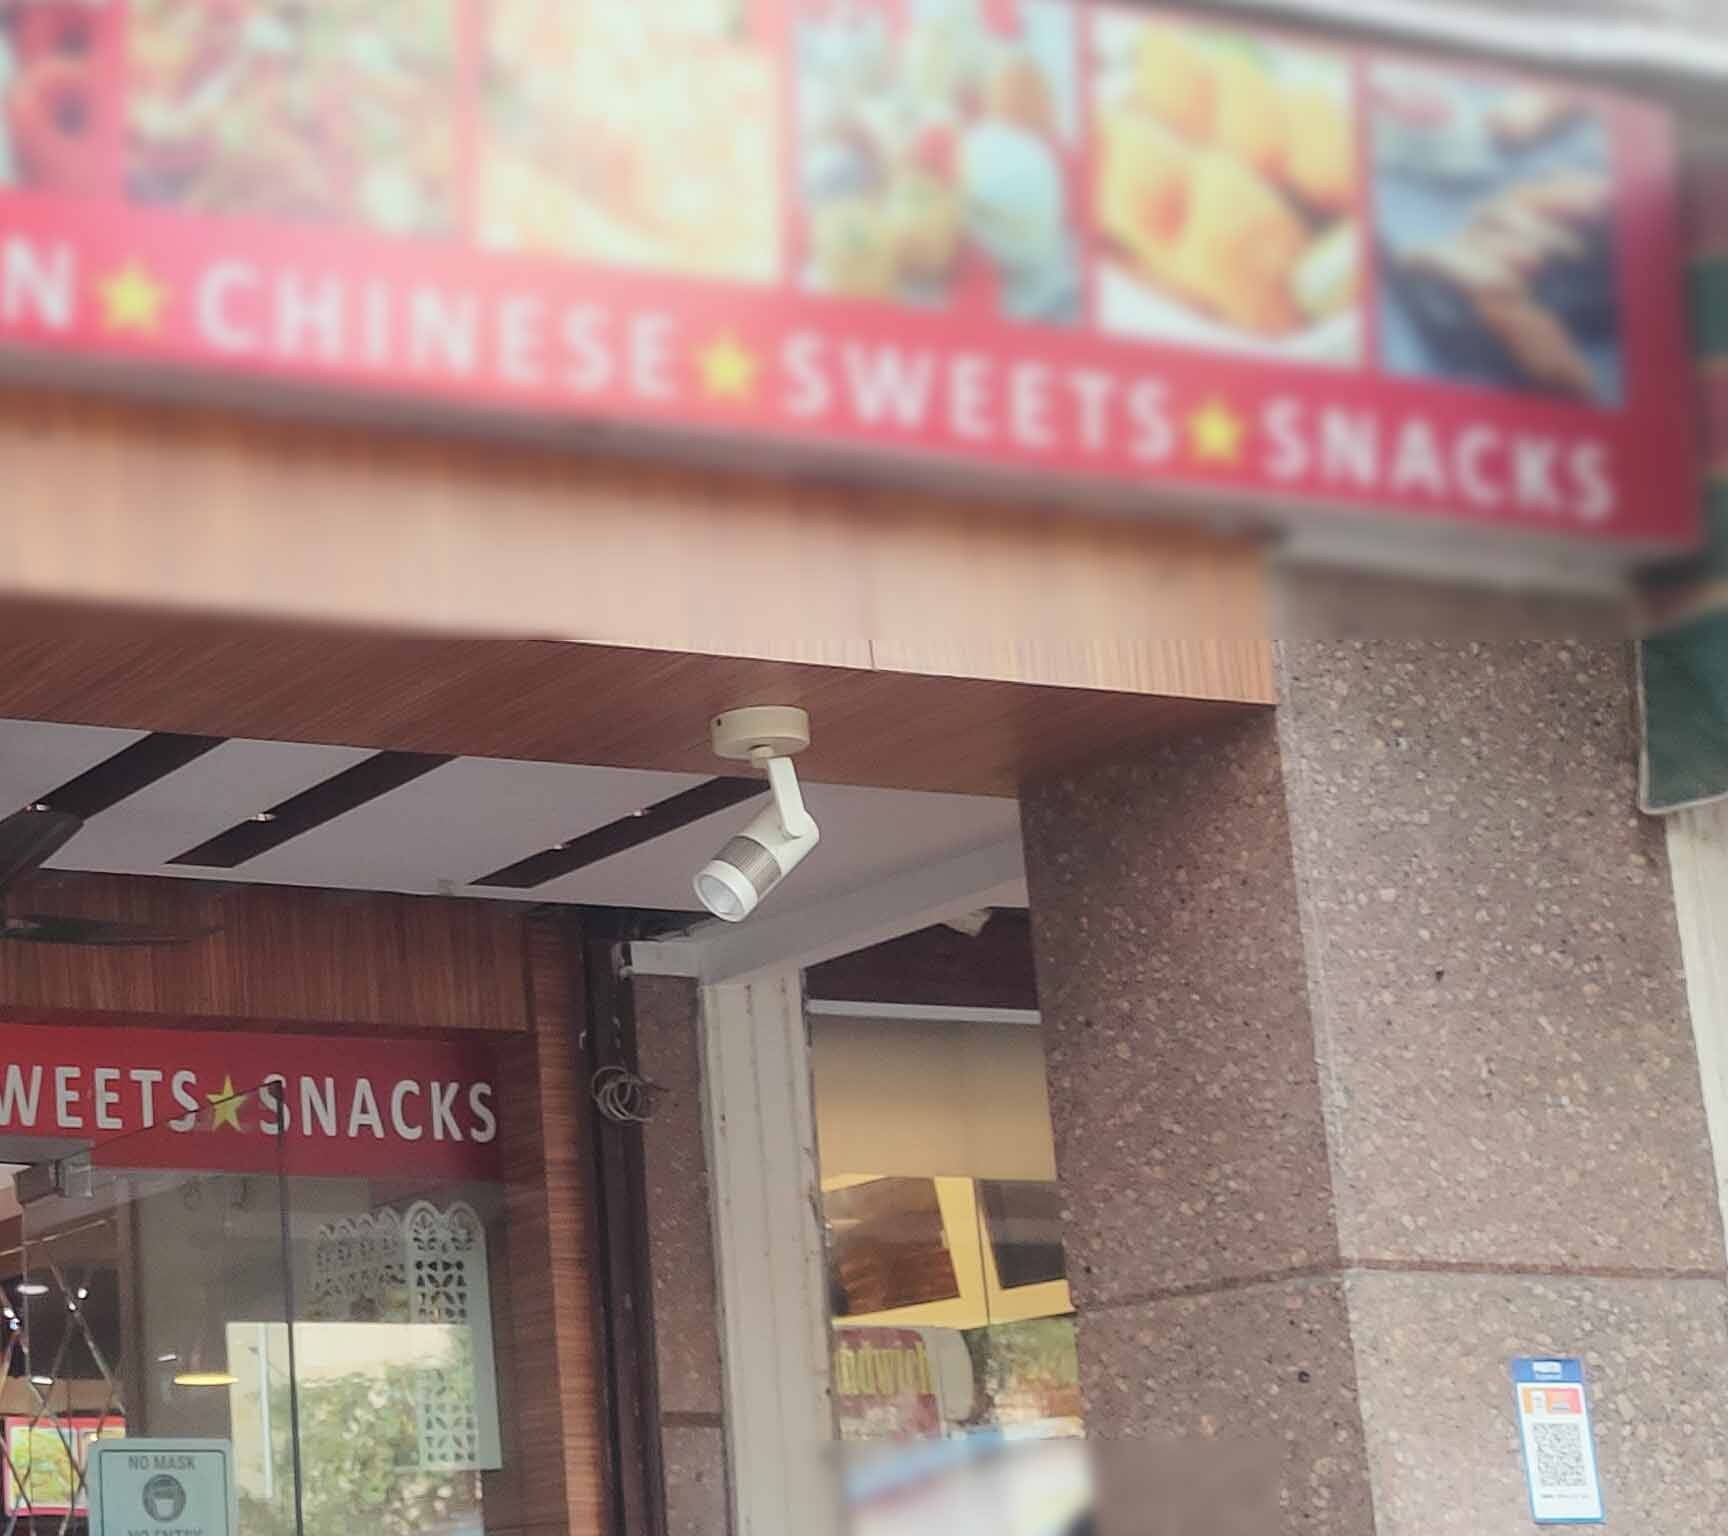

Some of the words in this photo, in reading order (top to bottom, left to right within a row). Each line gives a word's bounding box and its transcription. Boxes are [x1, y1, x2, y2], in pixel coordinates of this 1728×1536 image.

[197, 261, 677, 399] CHINESE
[785, 348, 1178, 465] SWEETS
[1267, 401, 1617, 524] SNACKS
[261, 1073, 497, 1143] SNACKS
[128, 1456, 149, 1470] NO
[153, 1456, 196, 1470] MASK
